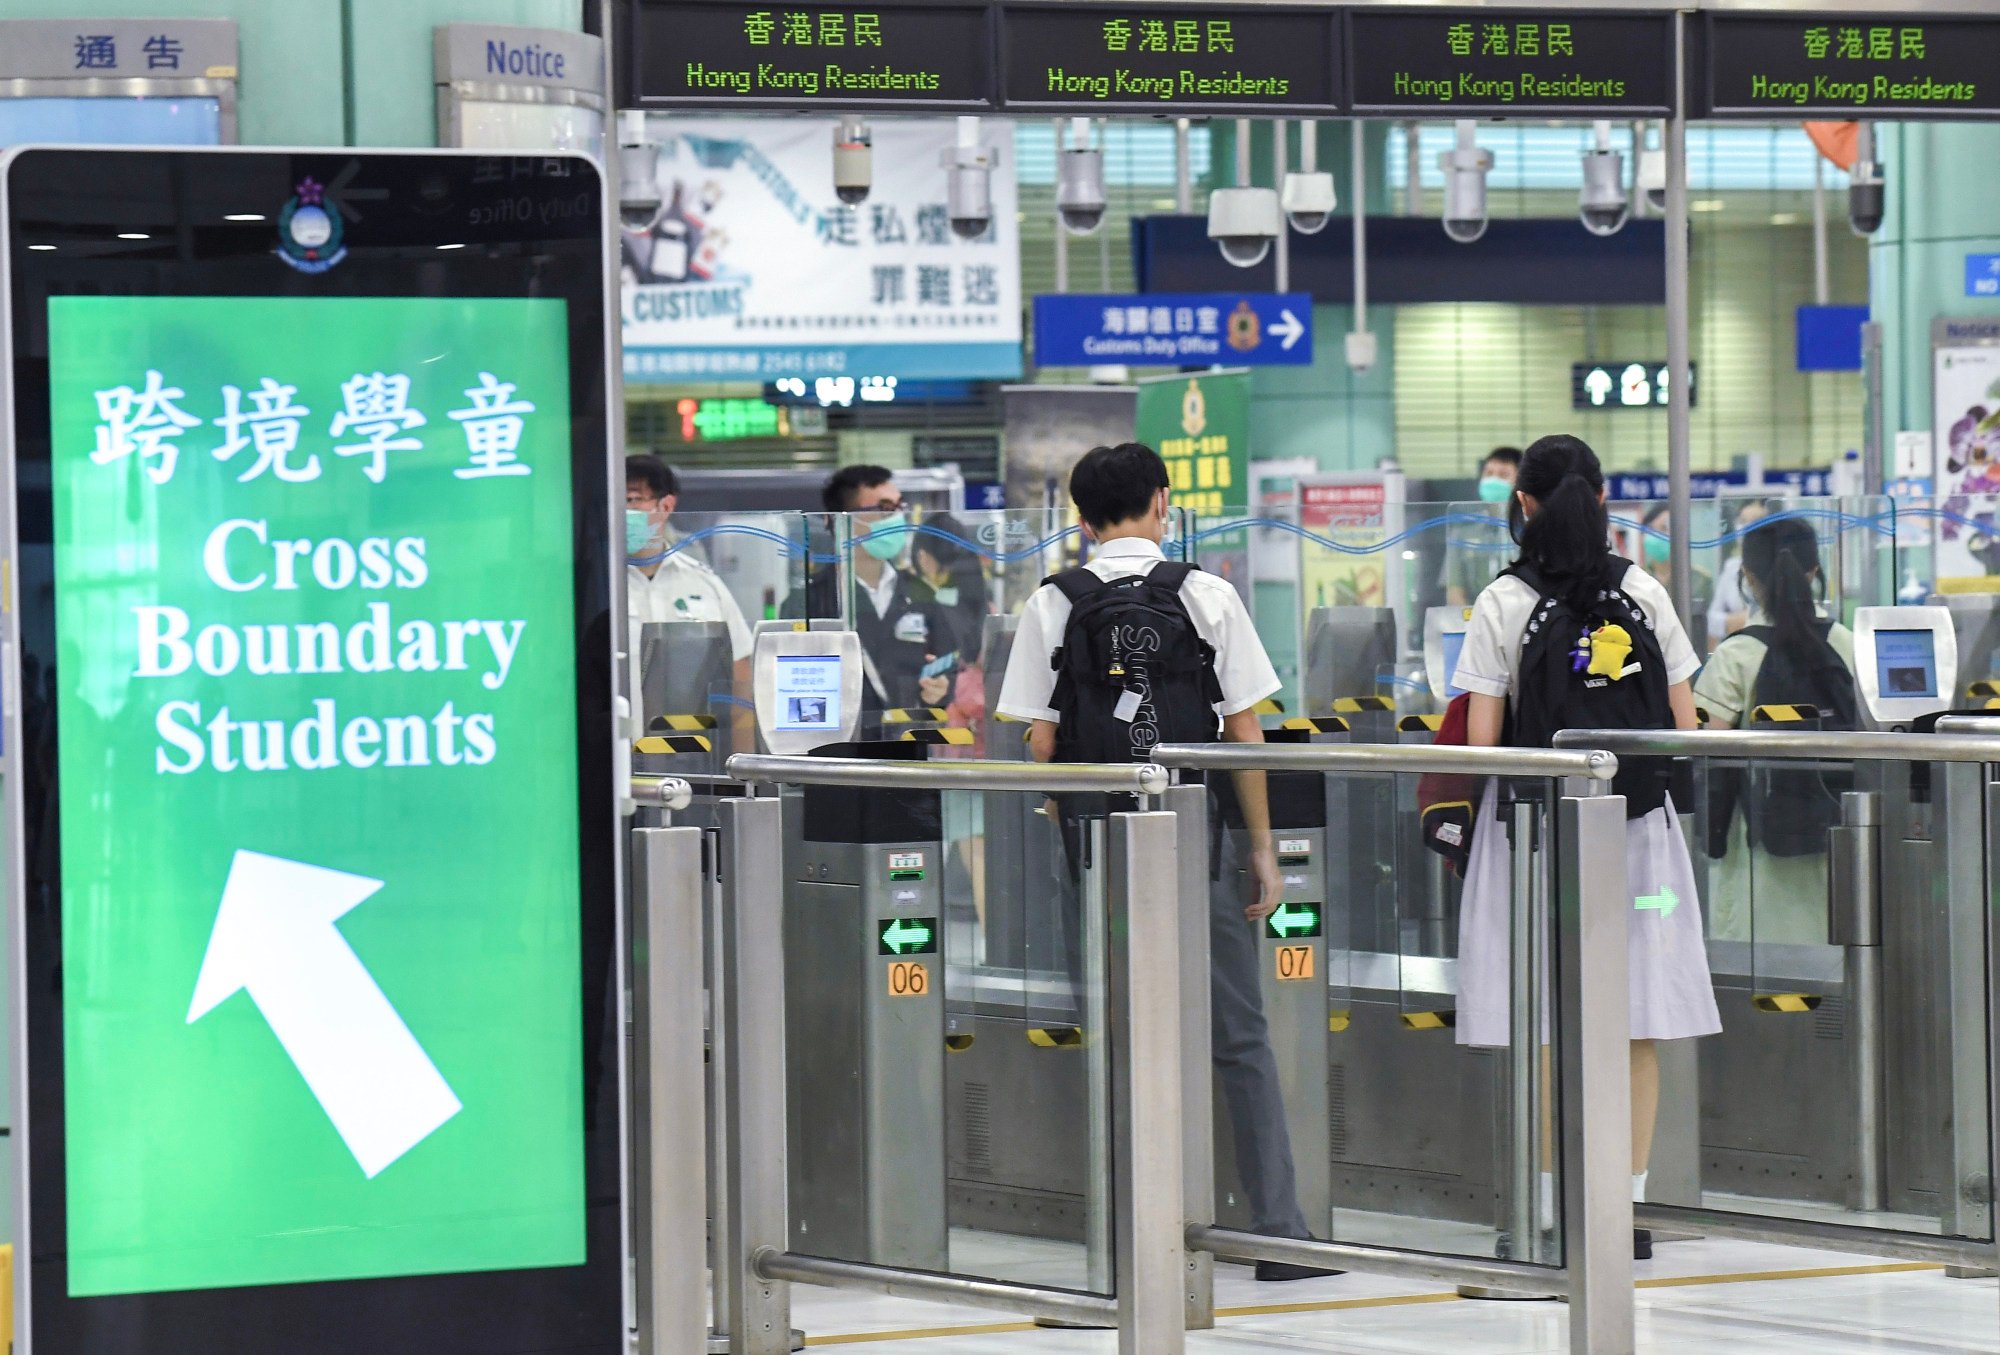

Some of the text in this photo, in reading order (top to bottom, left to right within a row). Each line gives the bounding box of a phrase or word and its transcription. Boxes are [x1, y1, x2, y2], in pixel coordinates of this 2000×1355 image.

[745, 12, 882, 46] 香港居民
[1104, 19, 1234, 53] 香港居民
[1448, 24, 1573, 56] 香港居民
[1805, 28, 1925, 59] 香港居民
[76, 34, 184, 70] 通告
[486, 40, 567, 79] Notice
[688, 64, 939, 93] Hong Kong Residents
[1048, 68, 1289, 98] Hong Kong Residents
[1395, 73, 1625, 100] Hong Kong Residents
[1752, 76, 1975, 103] Hong Kong Residents
[825, 203, 998, 247] 走私煙
[634, 287, 744, 322] CUSTOMS
[1083, 335, 1220, 358] Customs Duty Office
[89, 369, 537, 485] 跨境學童
[202, 518, 429, 592] Cross
[130, 601, 527, 690] Boundary
[155, 698, 497, 774] Students
[892, 963, 924, 994] 06
[1279, 946, 1309, 978] 07
